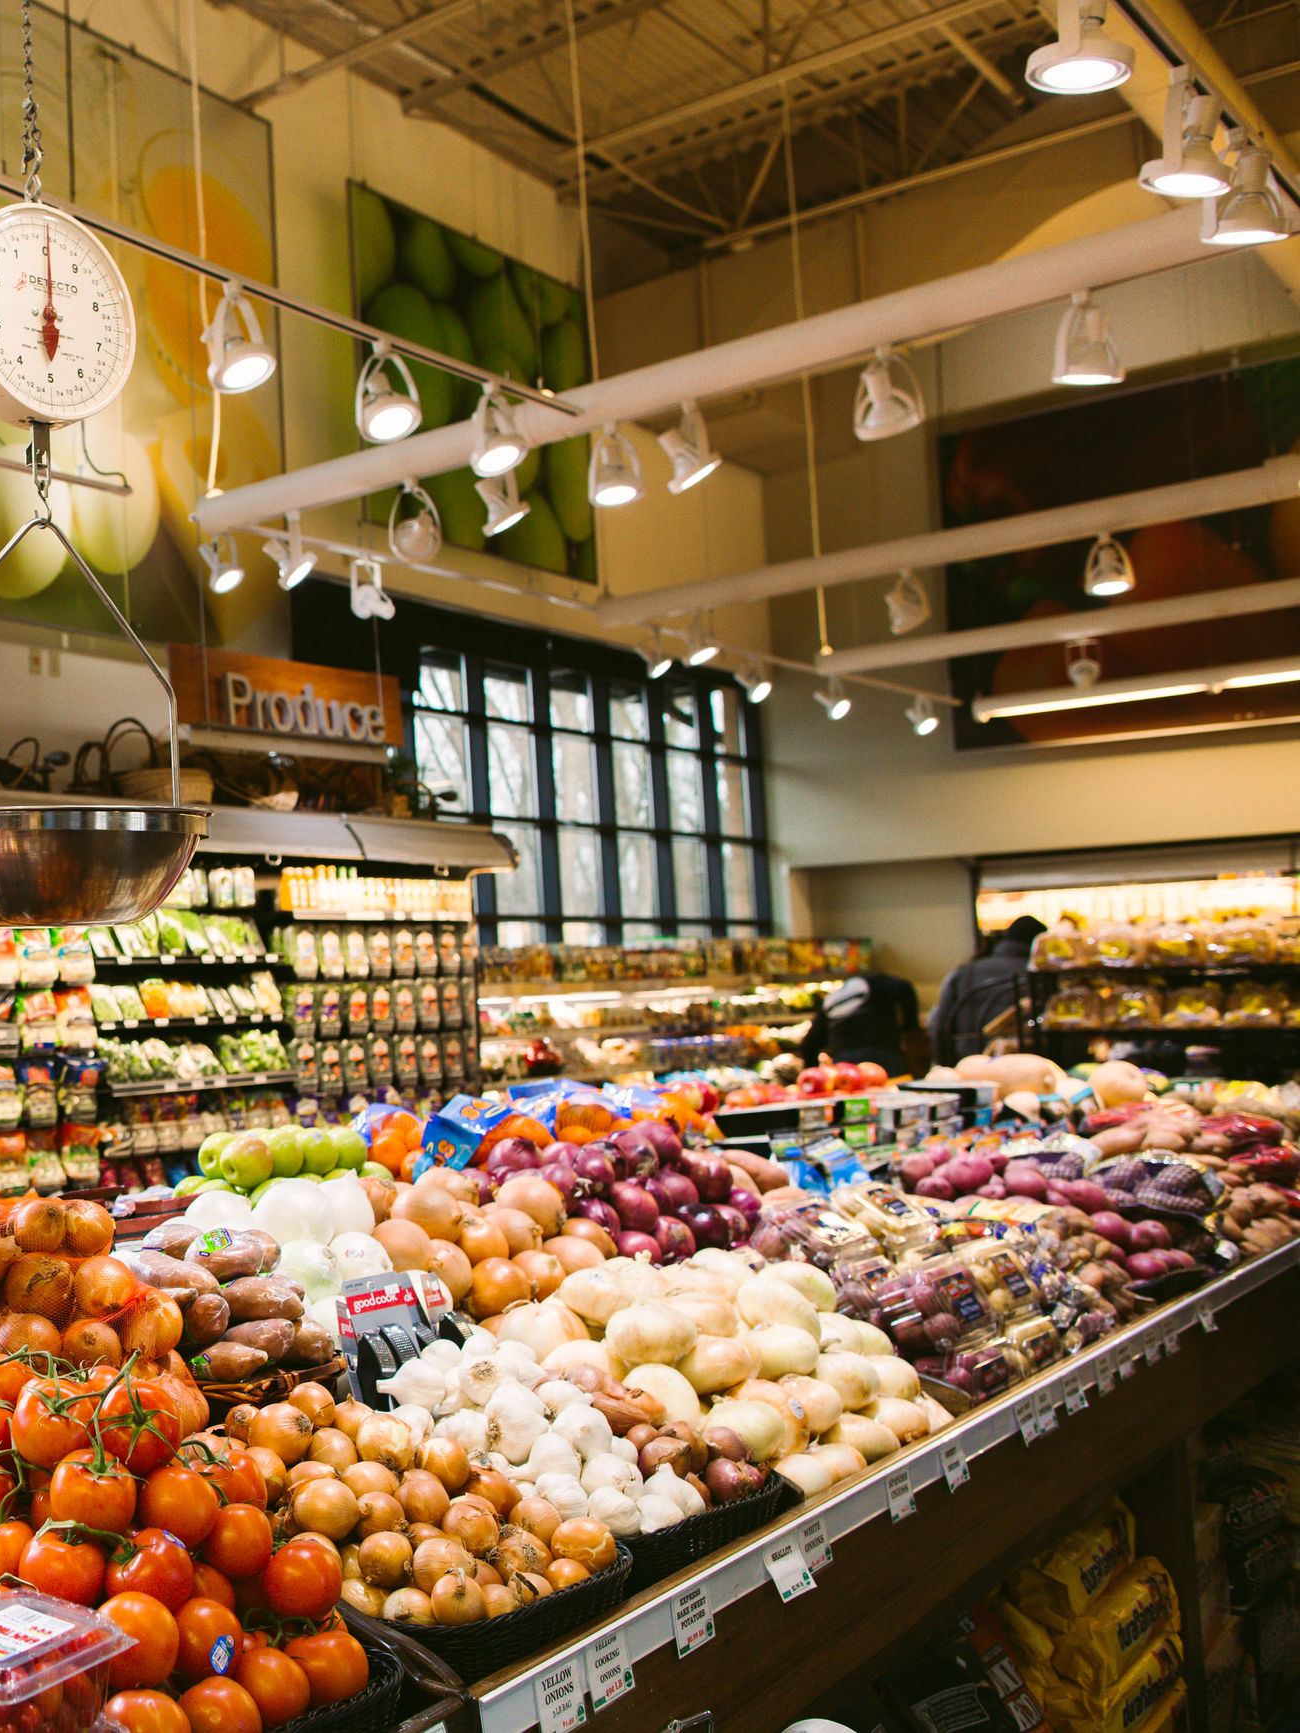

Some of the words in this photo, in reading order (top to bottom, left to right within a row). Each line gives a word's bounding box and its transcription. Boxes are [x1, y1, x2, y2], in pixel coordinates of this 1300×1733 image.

[13, 249, 19, 259] 1
[71, 263, 79, 274] 9
[29, 275, 78, 294] DETECTO
[92, 302, 99, 312] 8
[96, 342, 102, 352] 7
[16, 355, 23, 365] 4
[47, 373, 54, 383] 5
[77, 368, 84, 379] 6
[223, 671, 386, 743] Produce
[771, 1545, 792, 1562] SHALLOT
[679, 1588, 701, 1606] EXPRESS
[676, 1606, 689, 1620] BAKE
[690, 1597, 706, 1612] SWEET
[681, 1609, 706, 1630] POTATOES
[595, 1635, 617, 1652] YELLOW
[595, 1648, 620, 1668] COOKING
[541, 1666, 572, 1691] YELLOW
[600, 1664, 621, 1683] ONIONS
[545, 1681, 575, 1705] ONIONS
[614, 1679, 623, 1691] LB
